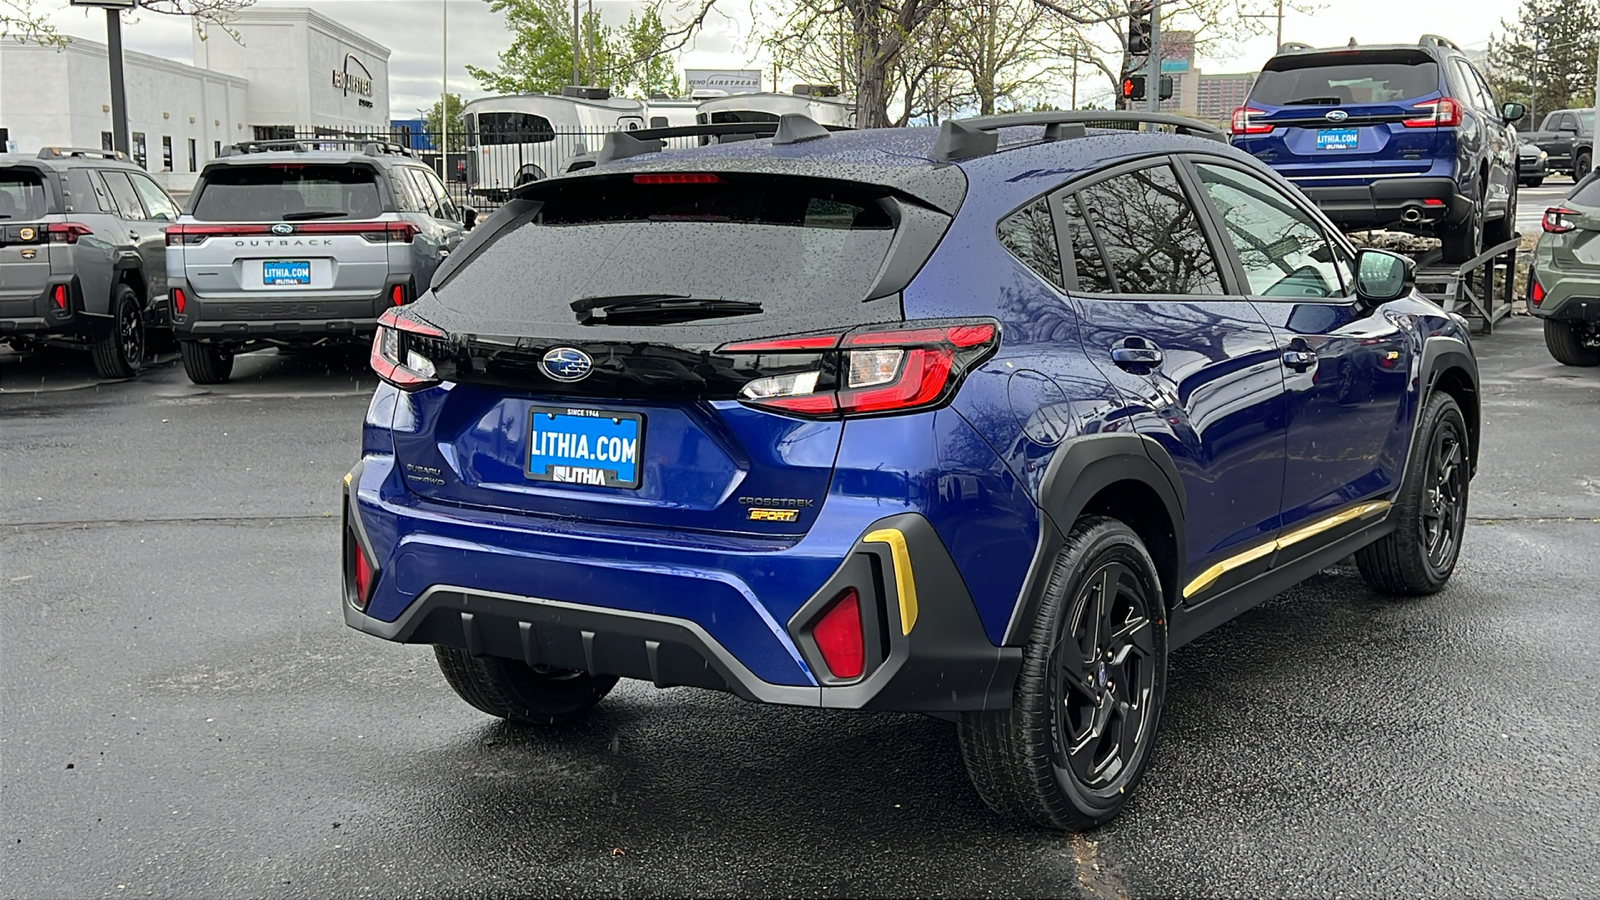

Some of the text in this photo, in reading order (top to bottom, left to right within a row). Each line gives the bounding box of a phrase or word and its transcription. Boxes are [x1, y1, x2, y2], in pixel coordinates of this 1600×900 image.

[1317, 134, 1357, 143] LITHIA.COM
[234, 239, 333, 247] OUTBACK
[264, 268, 309, 278] LITHIA.COM
[567, 408, 584, 417] SINCE
[531, 430, 637, 464] LITHIA.COM
[406, 463, 441, 476] SUBARU
[421, 476, 446, 486] AWD
[566, 466, 606, 486] LITHIA
[738, 496, 814, 507] CROSSTREK
[750, 510, 795, 521] SPORT
